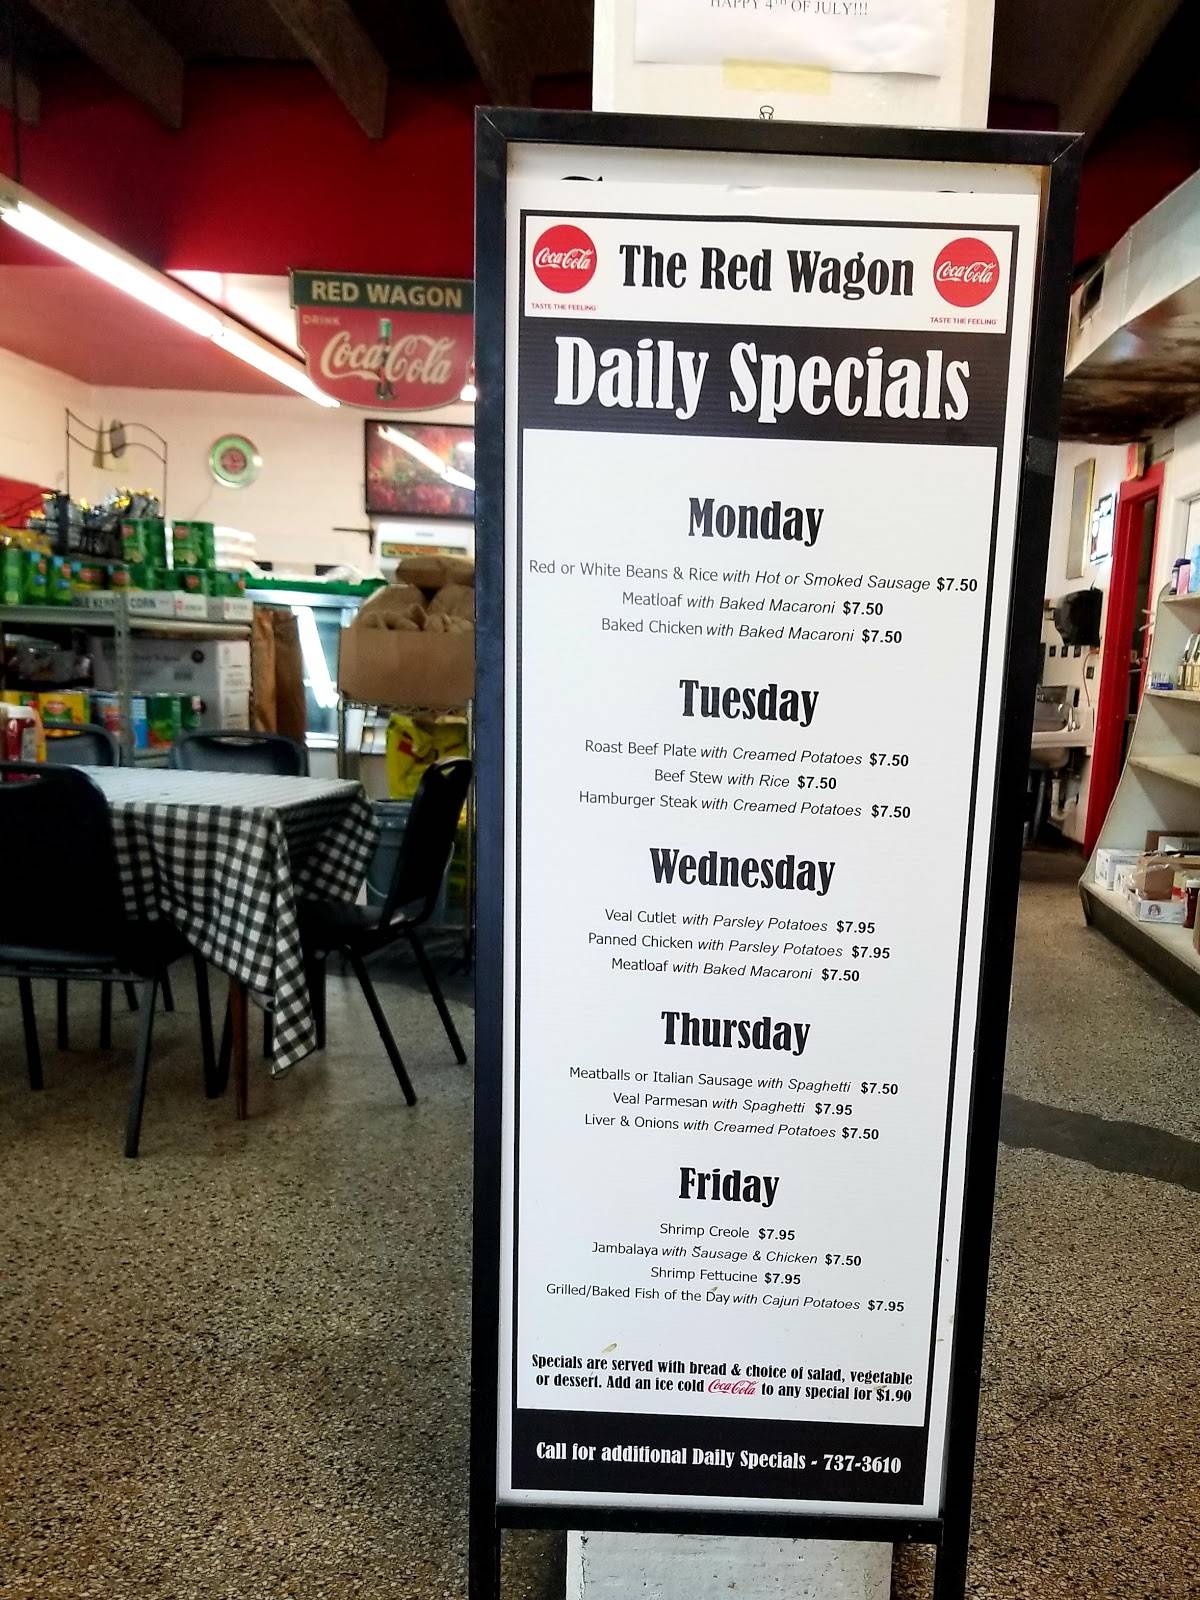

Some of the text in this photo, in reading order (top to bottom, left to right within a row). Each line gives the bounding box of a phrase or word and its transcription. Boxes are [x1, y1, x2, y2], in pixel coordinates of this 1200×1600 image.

[791, 1, 810, 12] OF
[814, 1, 868, 15] JULY!!!
[619, 244, 914, 300] The Red Wagon
[311, 280, 462, 308] RED WAGON
[302, 314, 341, 326] DRINK
[553, 335, 970, 423] Daily Specials
[688, 497, 824, 547] Monday
[529, 559, 977, 593] Red or White Beans & Rice with Hot or Smoked Sausage $7.50
[622, 591, 883, 616] Meatloaf with Baked Macaroni $7.50
[602, 617, 902, 644] Baked Chicken with Baked Macaroni $7.50
[679, 679, 819, 727] Tuesday
[585, 739, 909, 767] Roast Beef Plate with Creamed Potatoes $7.50
[654, 768, 836, 790] Beef Stew with Rice $7.50
[579, 790, 910, 818] Hamburger Steak with Creamed Potatoes $7.50
[649, 847, 836, 896] Wednesday
[605, 908, 875, 934] Veal Cutlet with Parsley Potatoes $7.95
[588, 932, 890, 959] Panned Chicken with Parsley Potatoes $7.95
[611, 957, 859, 982] Meatloaf with Baked Macaroni $7.50
[660, 1011, 811, 1056] Thursday
[569, 1066, 898, 1095] Meatballs or Italian Sausage with Spaghetti $7.50
[613, 1092, 852, 1115] Veal Parmesan with Spaghetti $7.95
[585, 1113, 879, 1140] Liver & Onions with Creamed Potatoes $7.50
[678, 1166, 780, 1208] Friday
[660, 1223, 795, 1241] Shrimp Creole $7.95
[591, 1241, 861, 1266] Jambalaya with Sausage & Chicken $7.50
[650, 1266, 801, 1285] Shrimp Fettucine $7.95
[546, 1283, 904, 1312] Grilled/Baked Fish of the Day with Cajun Potatoes $7.95
[532, 1353, 912, 1385] Specials are served with bread & choice of salad, vegetable
[536, 1374, 550, 1385] or
[553, 1373, 602, 1388] dessert.
[606, 1375, 631, 1389] Add
[634, 1378, 651, 1389] an
[655, 1377, 673, 1390] ice
[677, 1379, 704, 1392] cold
[761, 1382, 774, 1395] to
[778, 1385, 801, 1398] any
[805, 1385, 849, 1399] special
[853, 1386, 872, 1400] for
[876, 1388, 911, 1402] $1.90
[536, 1441, 567, 1459] Call
[572, 1442, 596, 1461] for
[601, 1444, 687, 1464] additional
[691, 1447, 735, 1468] Daily
[740, 1449, 806, 1469] Specials
[823, 1454, 901, 1473] 737-3610
